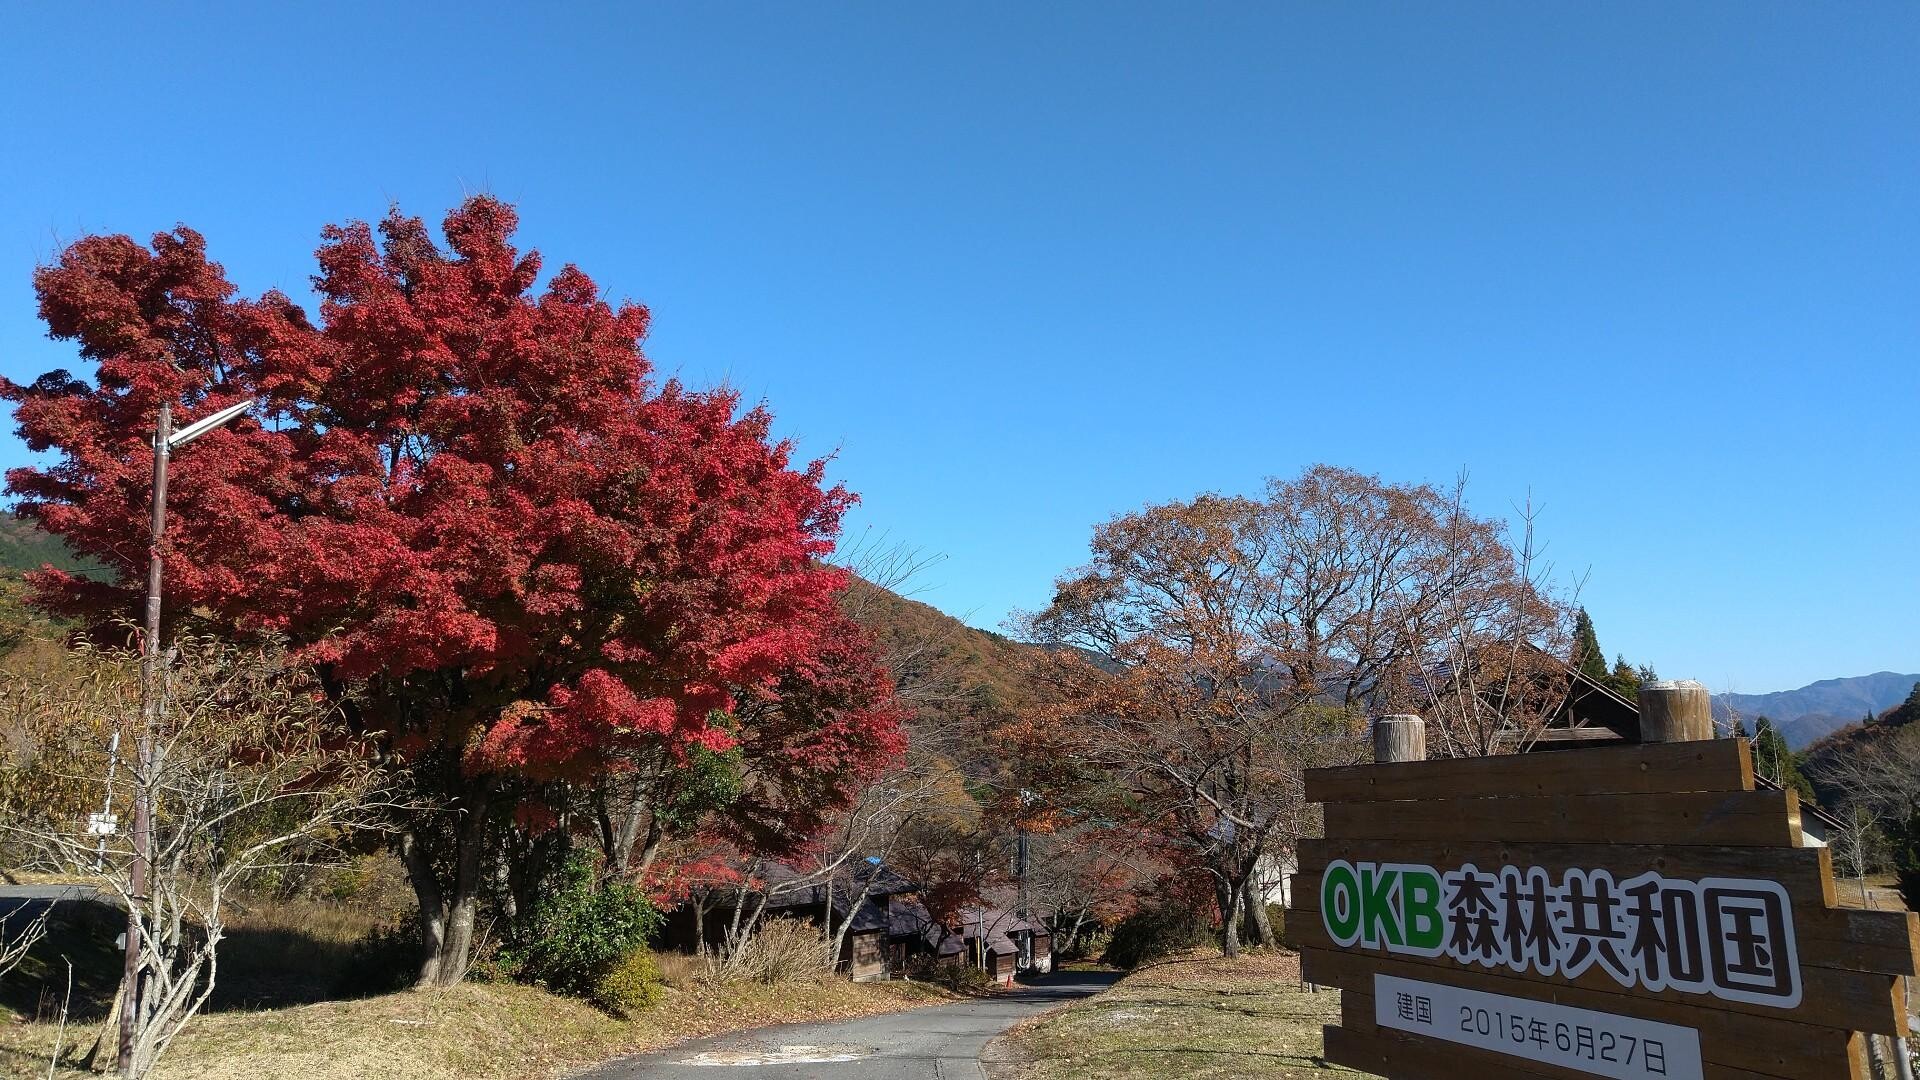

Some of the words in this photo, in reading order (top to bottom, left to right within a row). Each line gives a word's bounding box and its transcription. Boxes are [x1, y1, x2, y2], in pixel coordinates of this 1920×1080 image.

[1397, 993, 1433, 1026] 建国
[1460, 1006, 1667, 1076] 2015年6月27日
